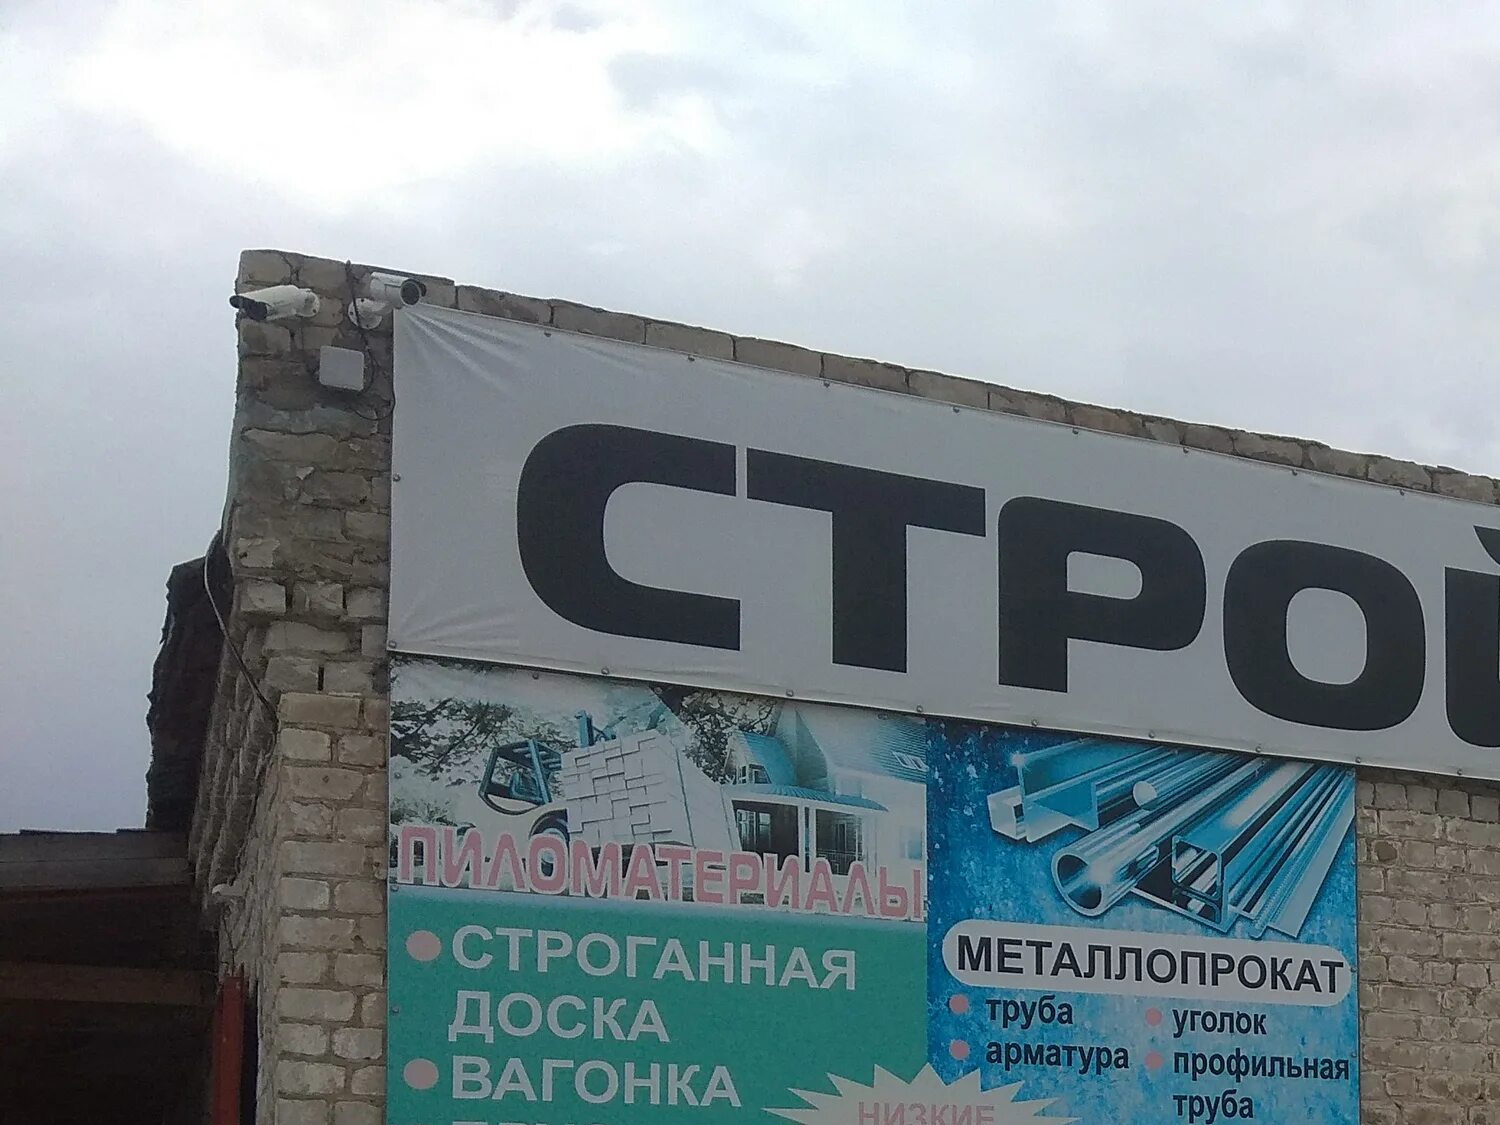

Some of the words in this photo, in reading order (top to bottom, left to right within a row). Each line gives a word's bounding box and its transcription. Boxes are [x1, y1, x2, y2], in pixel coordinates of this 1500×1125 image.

[397, 823, 926, 921] ПИЛОМАТЕРИАЛЫ
[452, 924, 856, 990] СТРОГАННАЯ
[957, 935, 1344, 993] МЕТАЛЛОПРОКАТ
[448, 990, 671, 1043] ДОСКА
[985, 996, 1073, 1028] труба
[1172, 1007, 1268, 1038] уголок
[985, 1041, 1130, 1075] арматура
[1173, 1047, 1349, 1081] профильная
[451, 1055, 743, 1107] ВАГОНКА
[1173, 1089, 1255, 1125] труба
